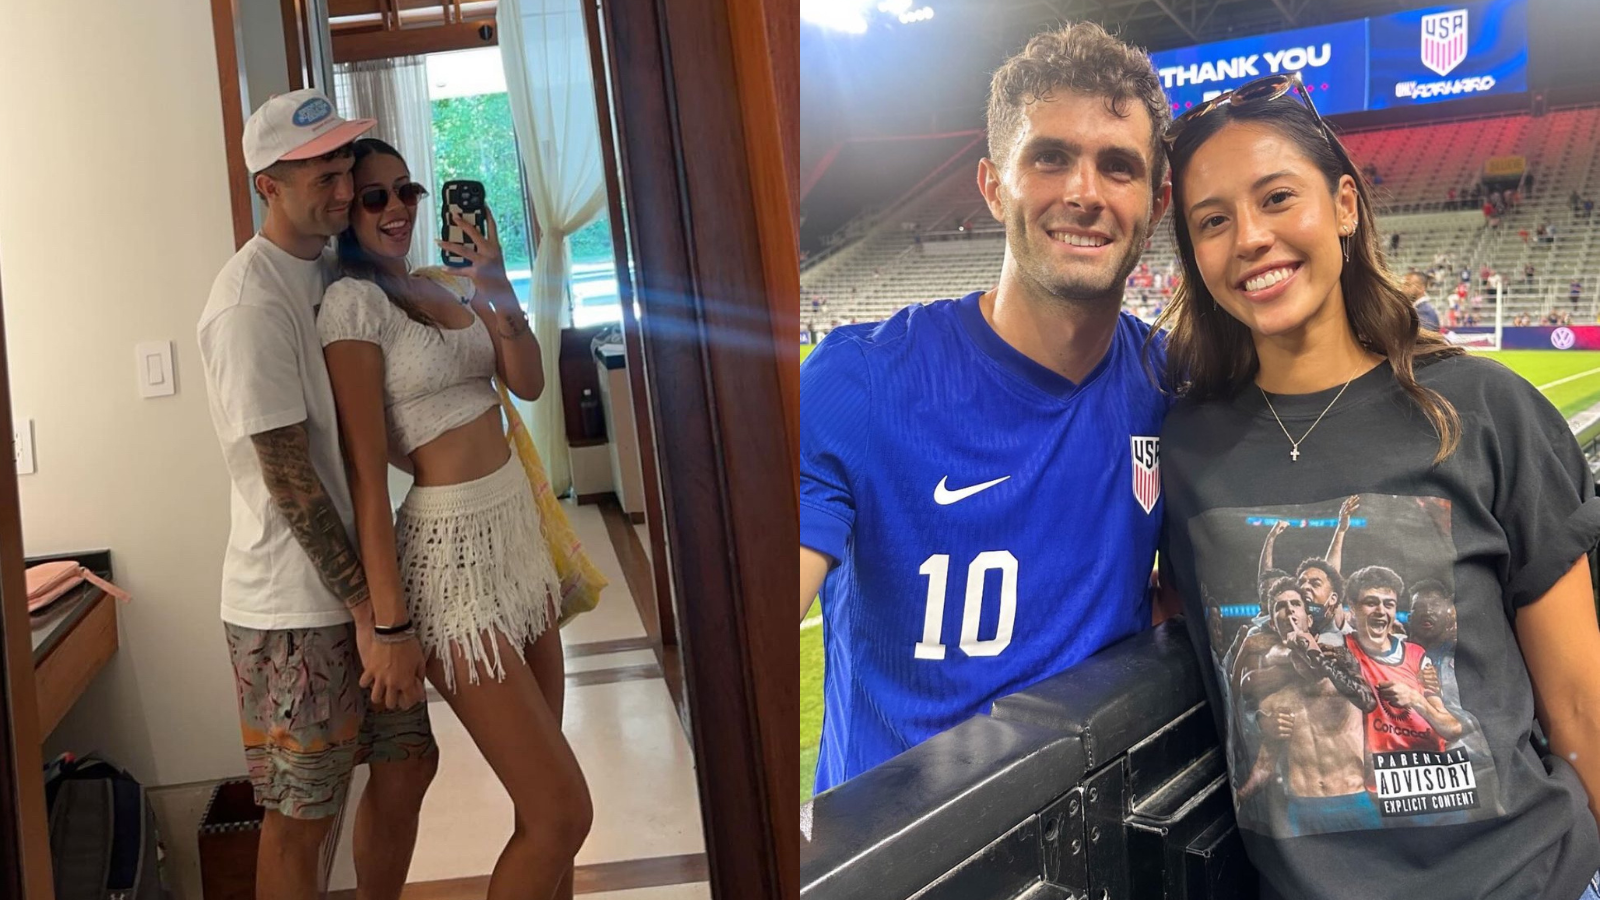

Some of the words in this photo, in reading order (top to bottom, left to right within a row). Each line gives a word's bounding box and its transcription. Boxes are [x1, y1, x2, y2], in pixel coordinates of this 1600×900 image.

[1426, 15, 1463, 39] USA
[1159, 54, 1259, 88] THANK
[1263, 43, 1331, 73] YOU
[914, 550, 1019, 660] 10
[1377, 750, 1465, 768] PARENTAL
[1380, 763, 1470, 795] ADVISORY
[1384, 797, 1427, 813] EXPLICIT
[1432, 791, 1475, 809] CONTENT
